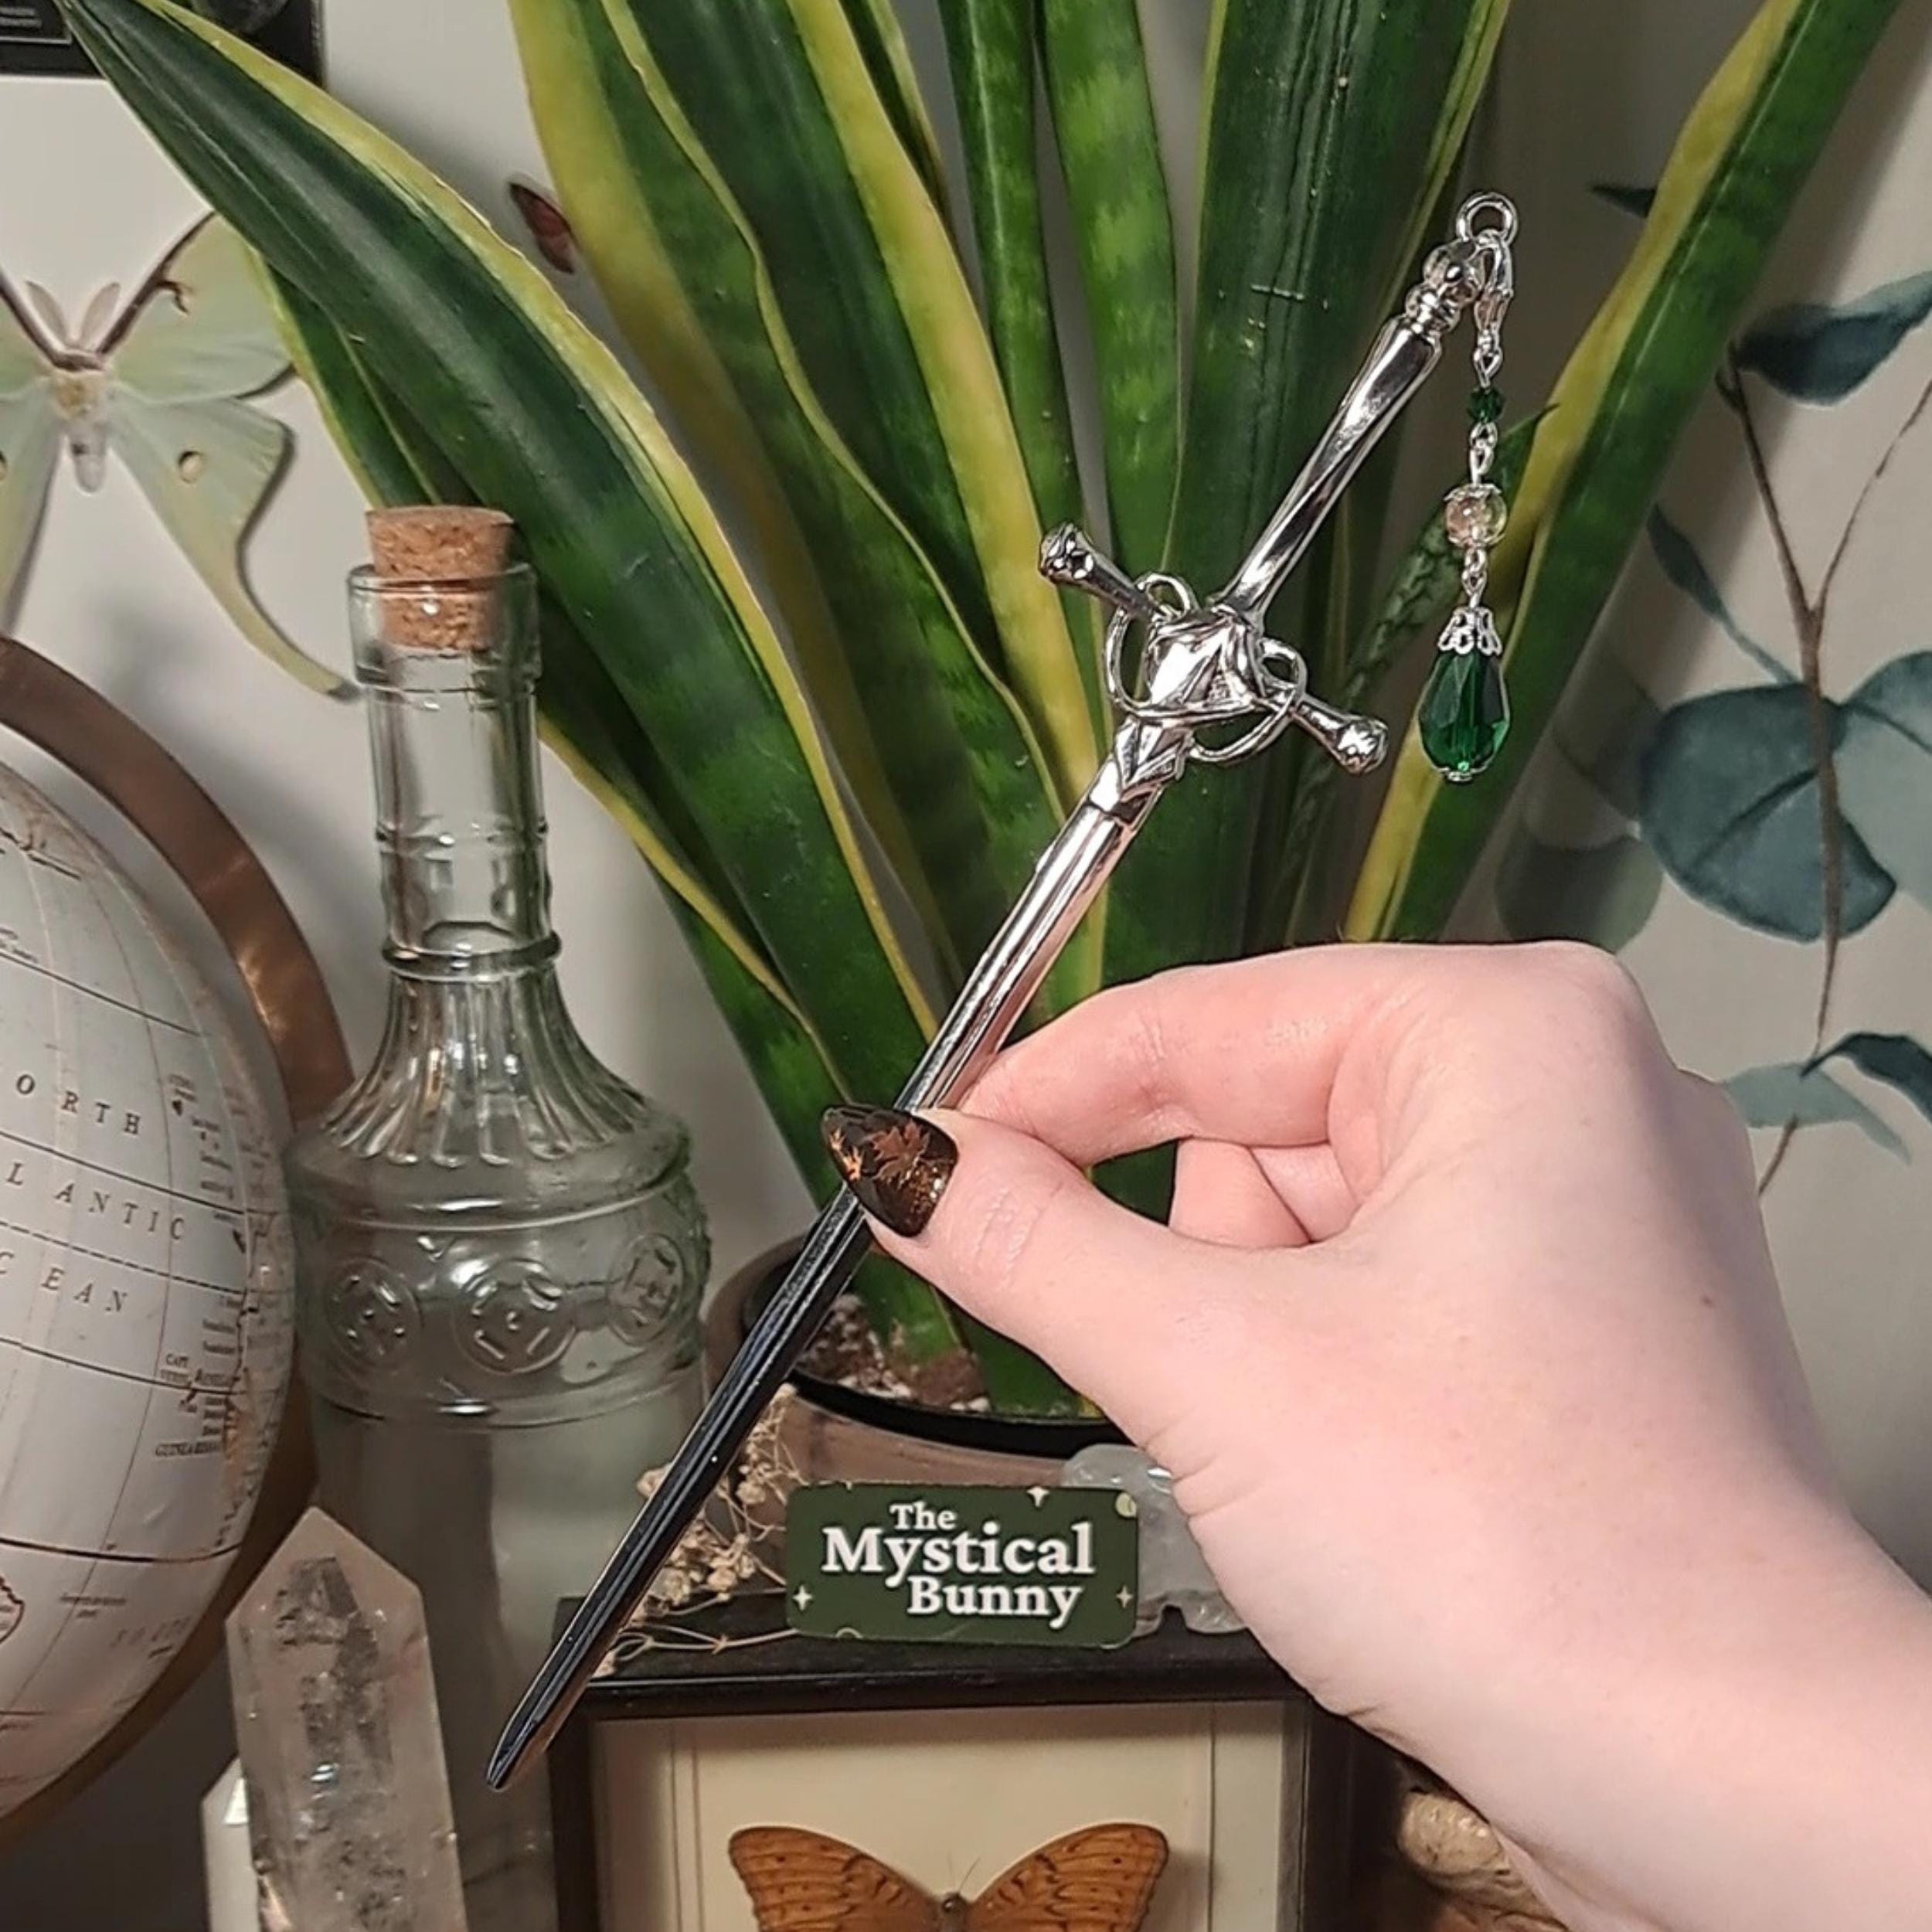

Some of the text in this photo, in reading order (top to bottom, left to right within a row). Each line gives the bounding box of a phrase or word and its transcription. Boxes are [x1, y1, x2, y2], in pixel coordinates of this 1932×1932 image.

[15, 1073, 141, 1134] ORTH
[889, 1501, 957, 1531] The
[821, 1521, 1096, 1588] Mystical
[906, 1575, 1083, 1629] Bunny
